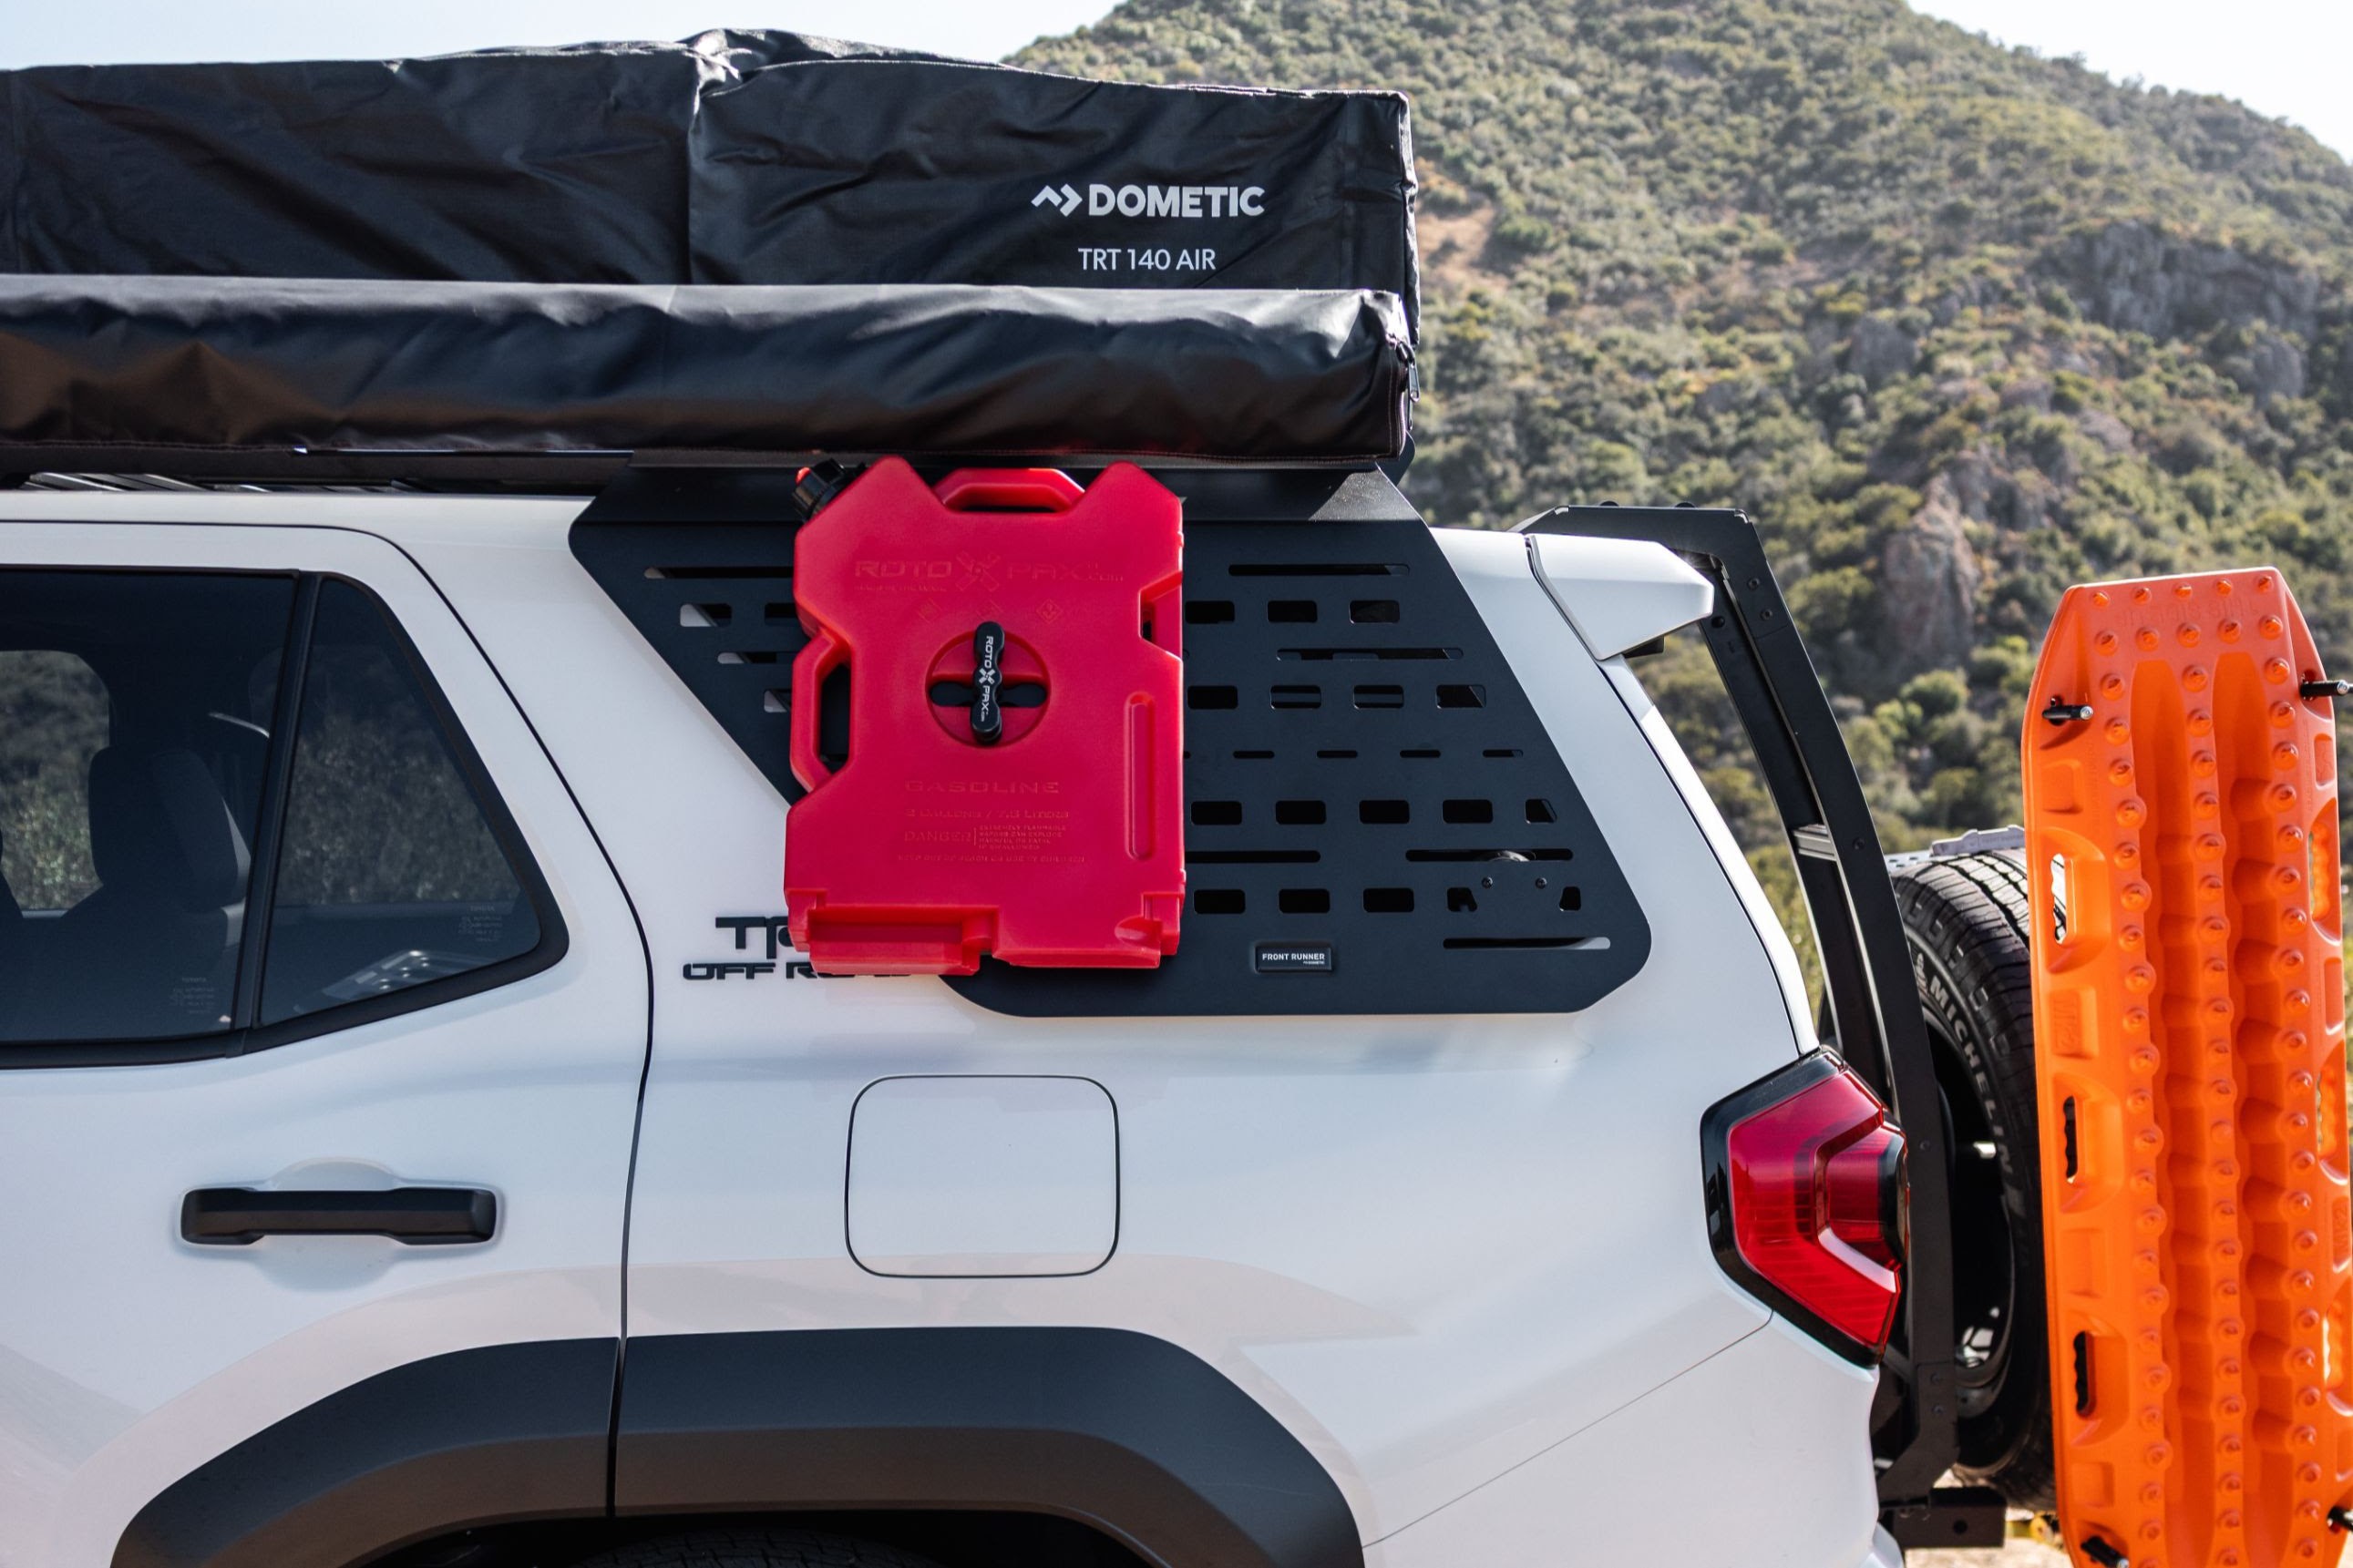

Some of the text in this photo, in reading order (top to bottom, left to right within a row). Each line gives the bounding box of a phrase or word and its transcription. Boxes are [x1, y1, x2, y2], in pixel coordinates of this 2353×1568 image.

[1088, 183, 1266, 218] DOMETIC
[1077, 247, 1217, 271] TRT 140 AIR
[983, 635, 994, 669] ROTO
[904, 780, 1060, 794] GASOLINE
[904, 830, 971, 843] DANGER
[683, 962, 776, 980] OFF
[1929, 975, 2014, 1175] MICHELIN
